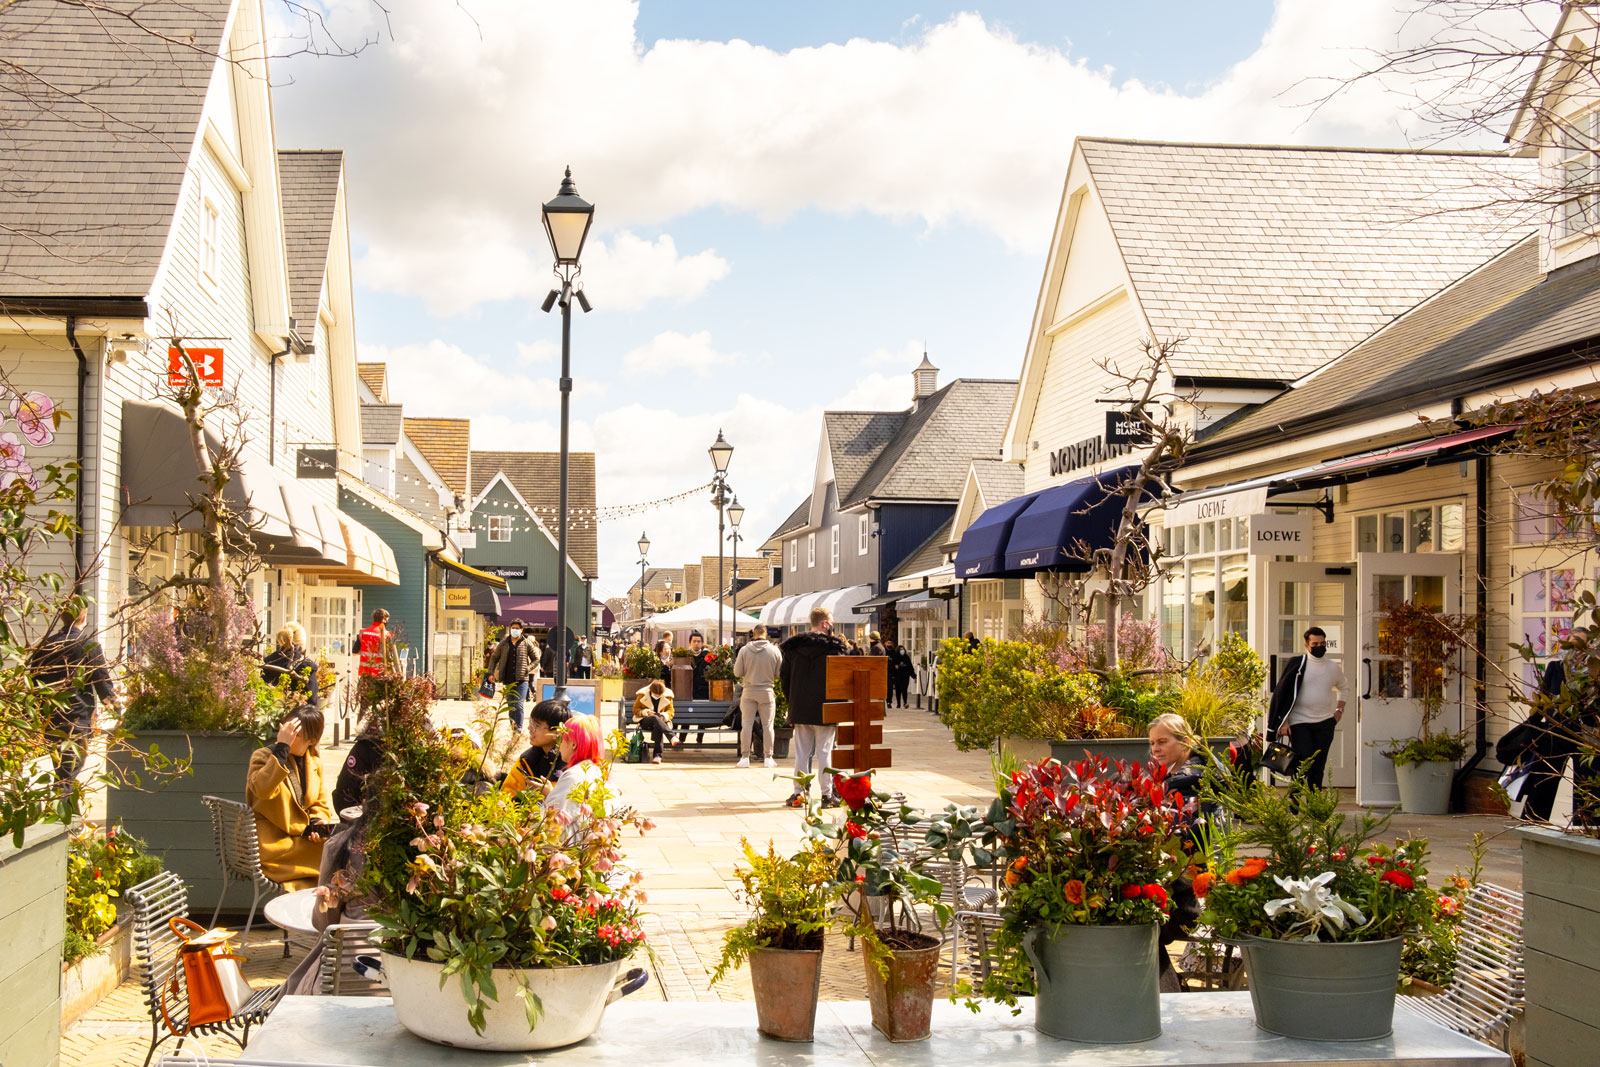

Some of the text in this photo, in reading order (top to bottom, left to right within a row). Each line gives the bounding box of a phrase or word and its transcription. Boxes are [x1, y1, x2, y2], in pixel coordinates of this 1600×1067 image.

[1115, 421, 1141, 429] MONT
[1197, 499, 1227, 519] LOEWE
[1257, 530, 1301, 542] LOEWE
[496, 569, 525, 577] Westwood
[448, 593, 467, 601] Chloé
